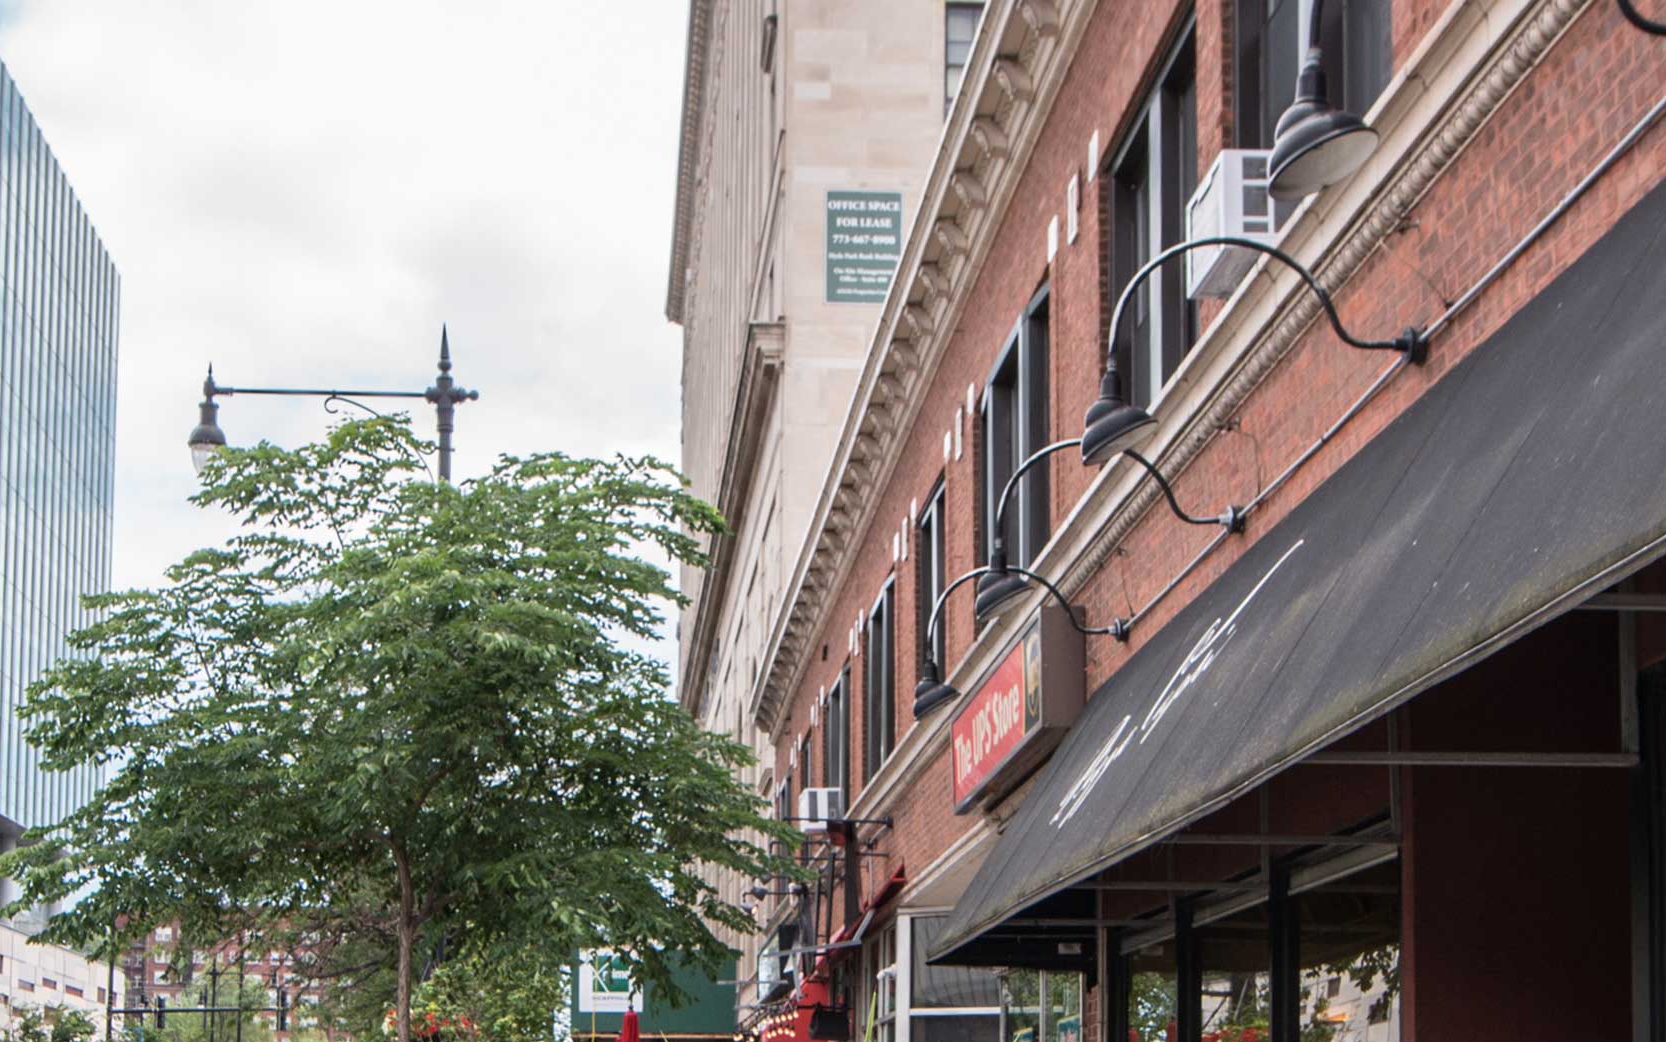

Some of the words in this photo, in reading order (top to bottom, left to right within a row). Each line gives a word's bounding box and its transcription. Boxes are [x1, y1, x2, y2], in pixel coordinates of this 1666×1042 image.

[828, 200, 866, 211] OFFICE
[868, 201, 900, 212] SPACE
[836, 217, 858, 228] FOR
[860, 217, 892, 229] LEASE
[954, 733, 973, 785] The
[972, 702, 992, 765] UPS
[992, 683, 1020, 746] Store
